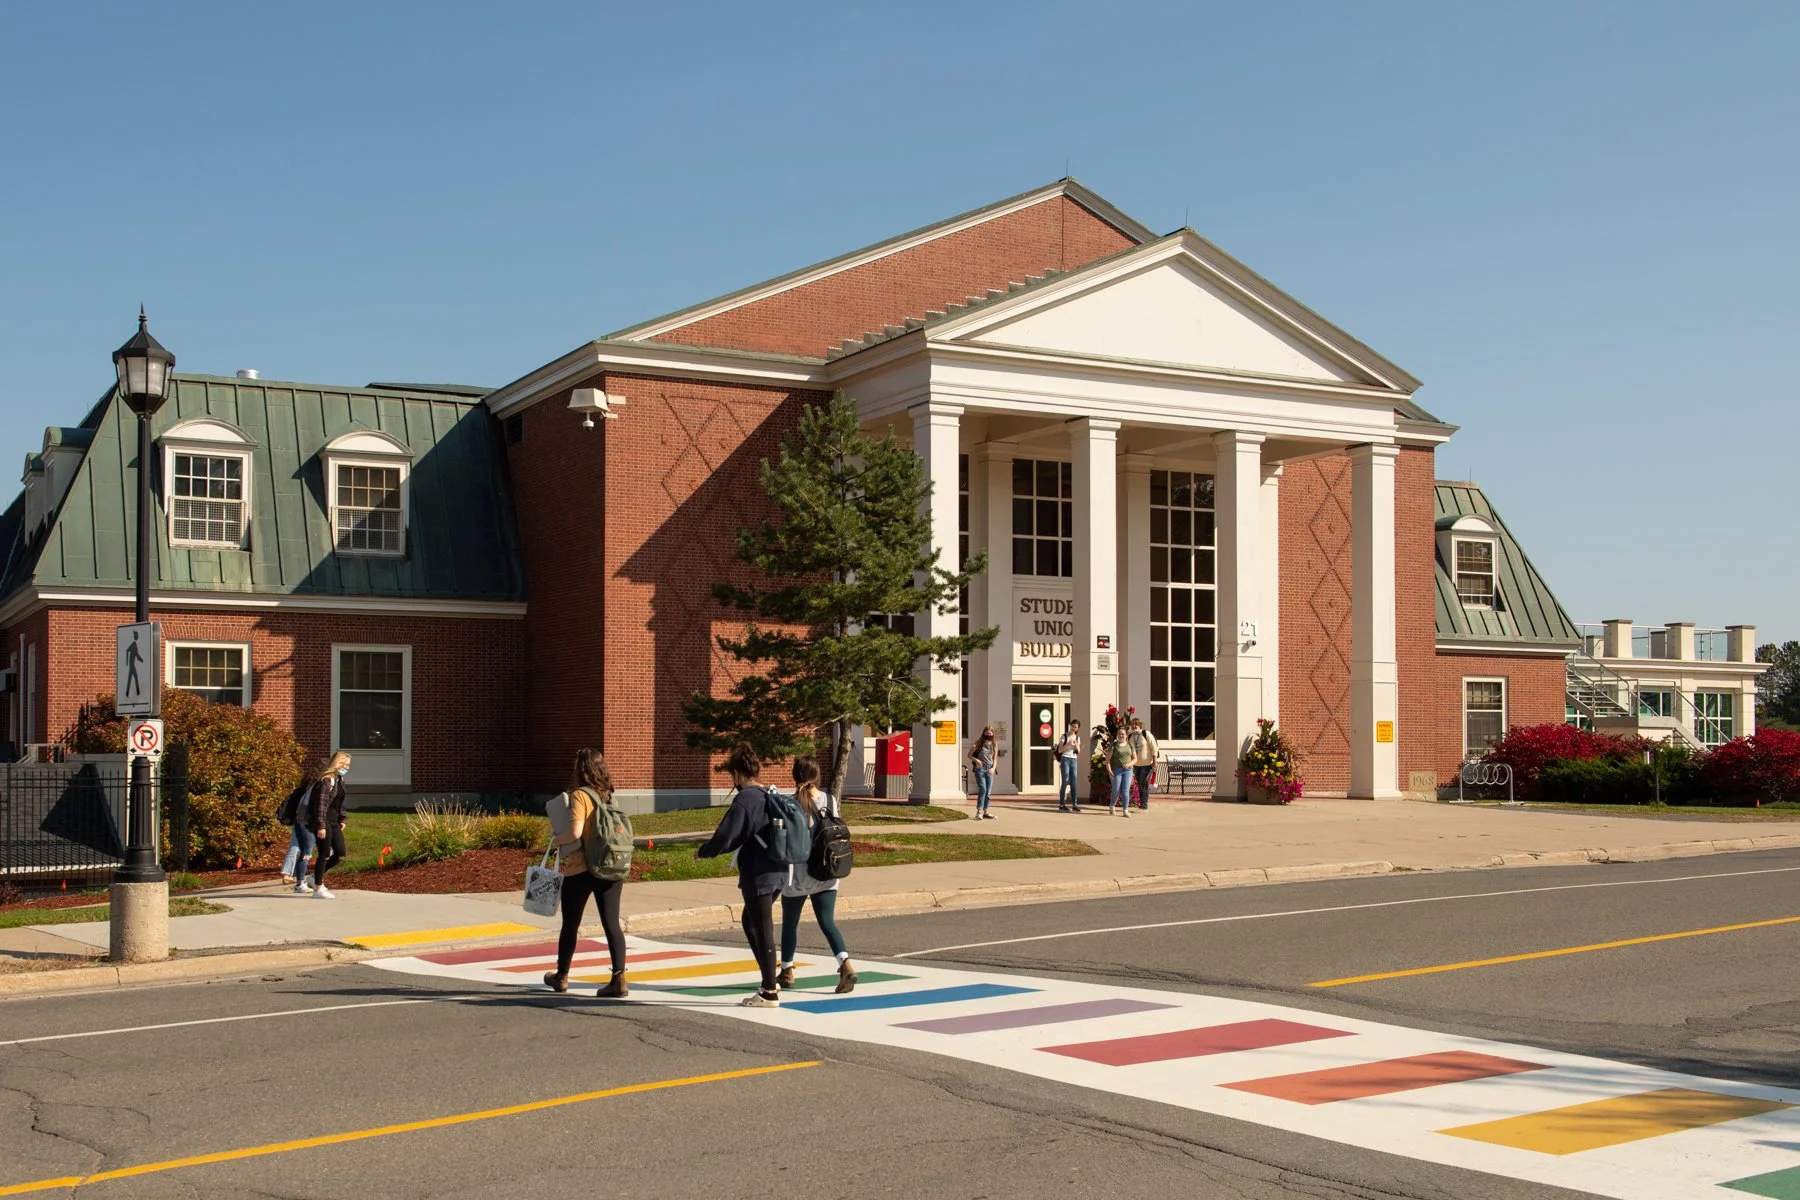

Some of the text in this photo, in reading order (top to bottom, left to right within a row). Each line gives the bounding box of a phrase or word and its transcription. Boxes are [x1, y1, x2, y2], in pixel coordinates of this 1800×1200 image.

[1020, 598, 1073, 615] STUDE
[1033, 620, 1073, 637] UNIO
[1240, 620, 1257, 637] 21
[1020, 641, 1072, 658] BUILD
[140, 729, 153, 747] P
[1413, 775, 1434, 787] 1968
